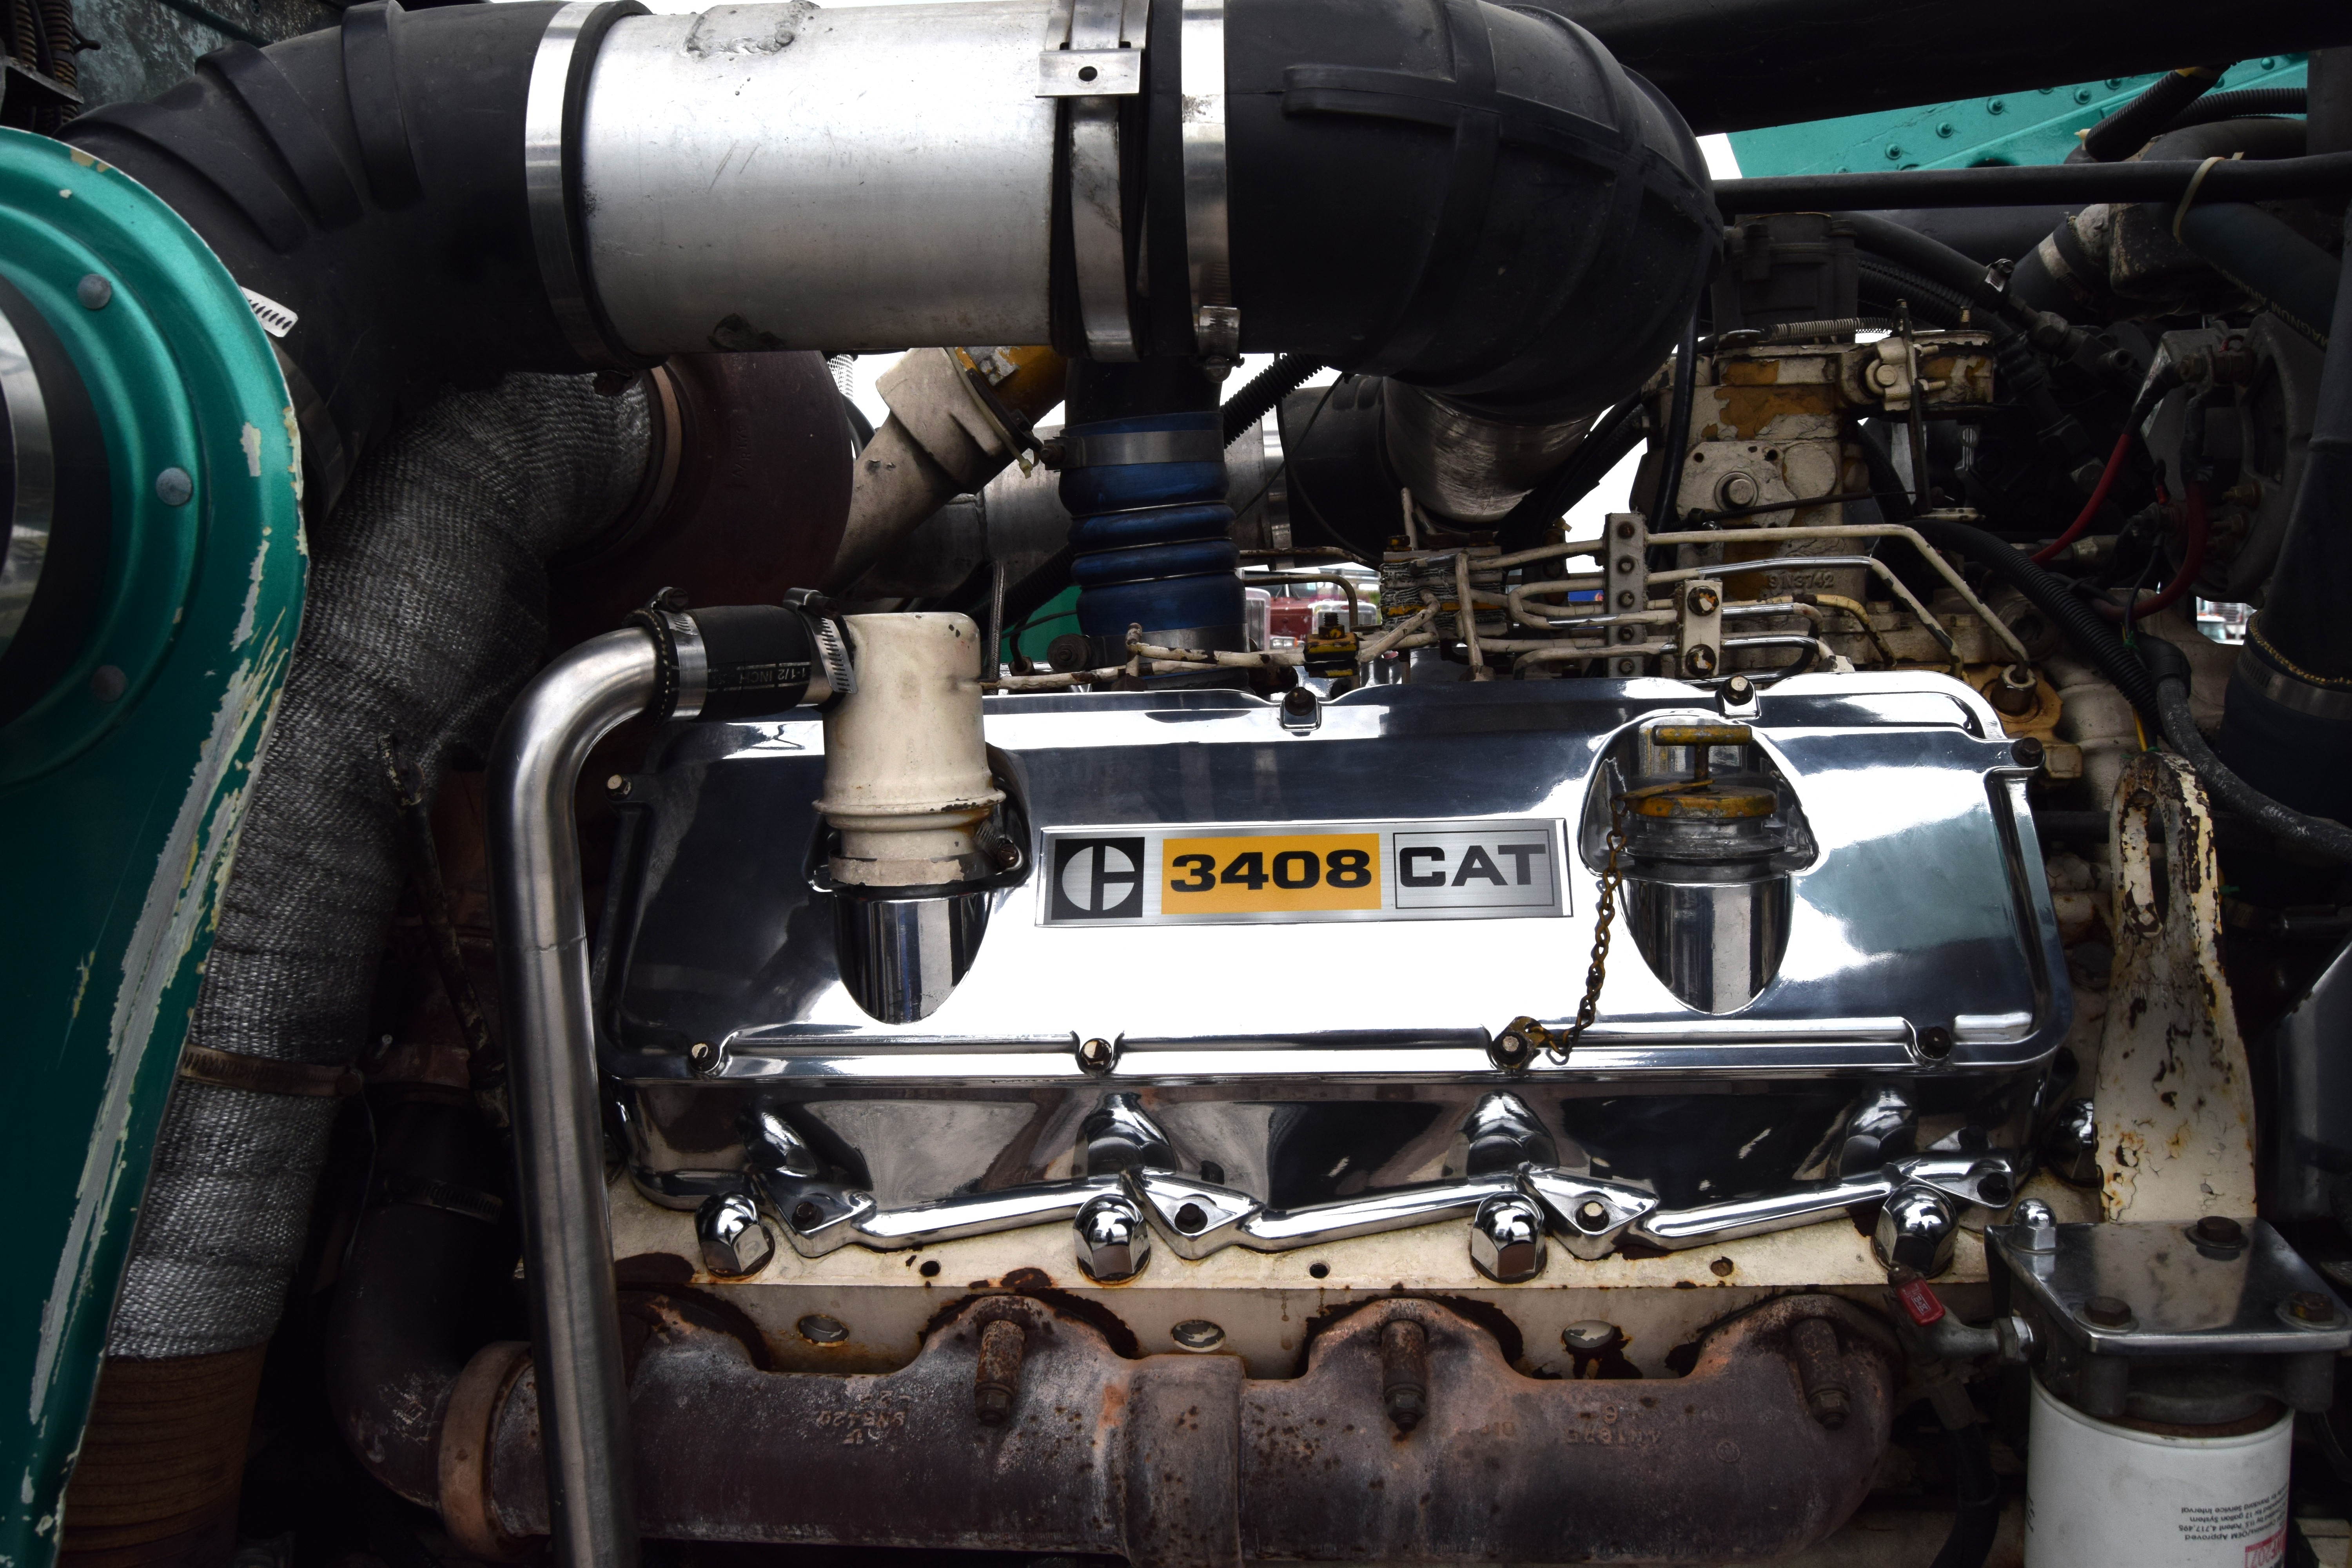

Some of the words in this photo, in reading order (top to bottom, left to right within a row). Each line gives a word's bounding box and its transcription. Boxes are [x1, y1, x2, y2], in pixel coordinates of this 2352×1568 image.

[2270, 301, 2329, 347] MAGNUM
[740, 670, 773, 684] INCH
[777, 668, 806, 681] 1-1/2
[1170, 849, 1371, 893] 3408
[1399, 844, 1546, 888] CAT
[2221, 1512, 2243, 1521] gallon
[2219, 1523, 2241, 1531] Patent
